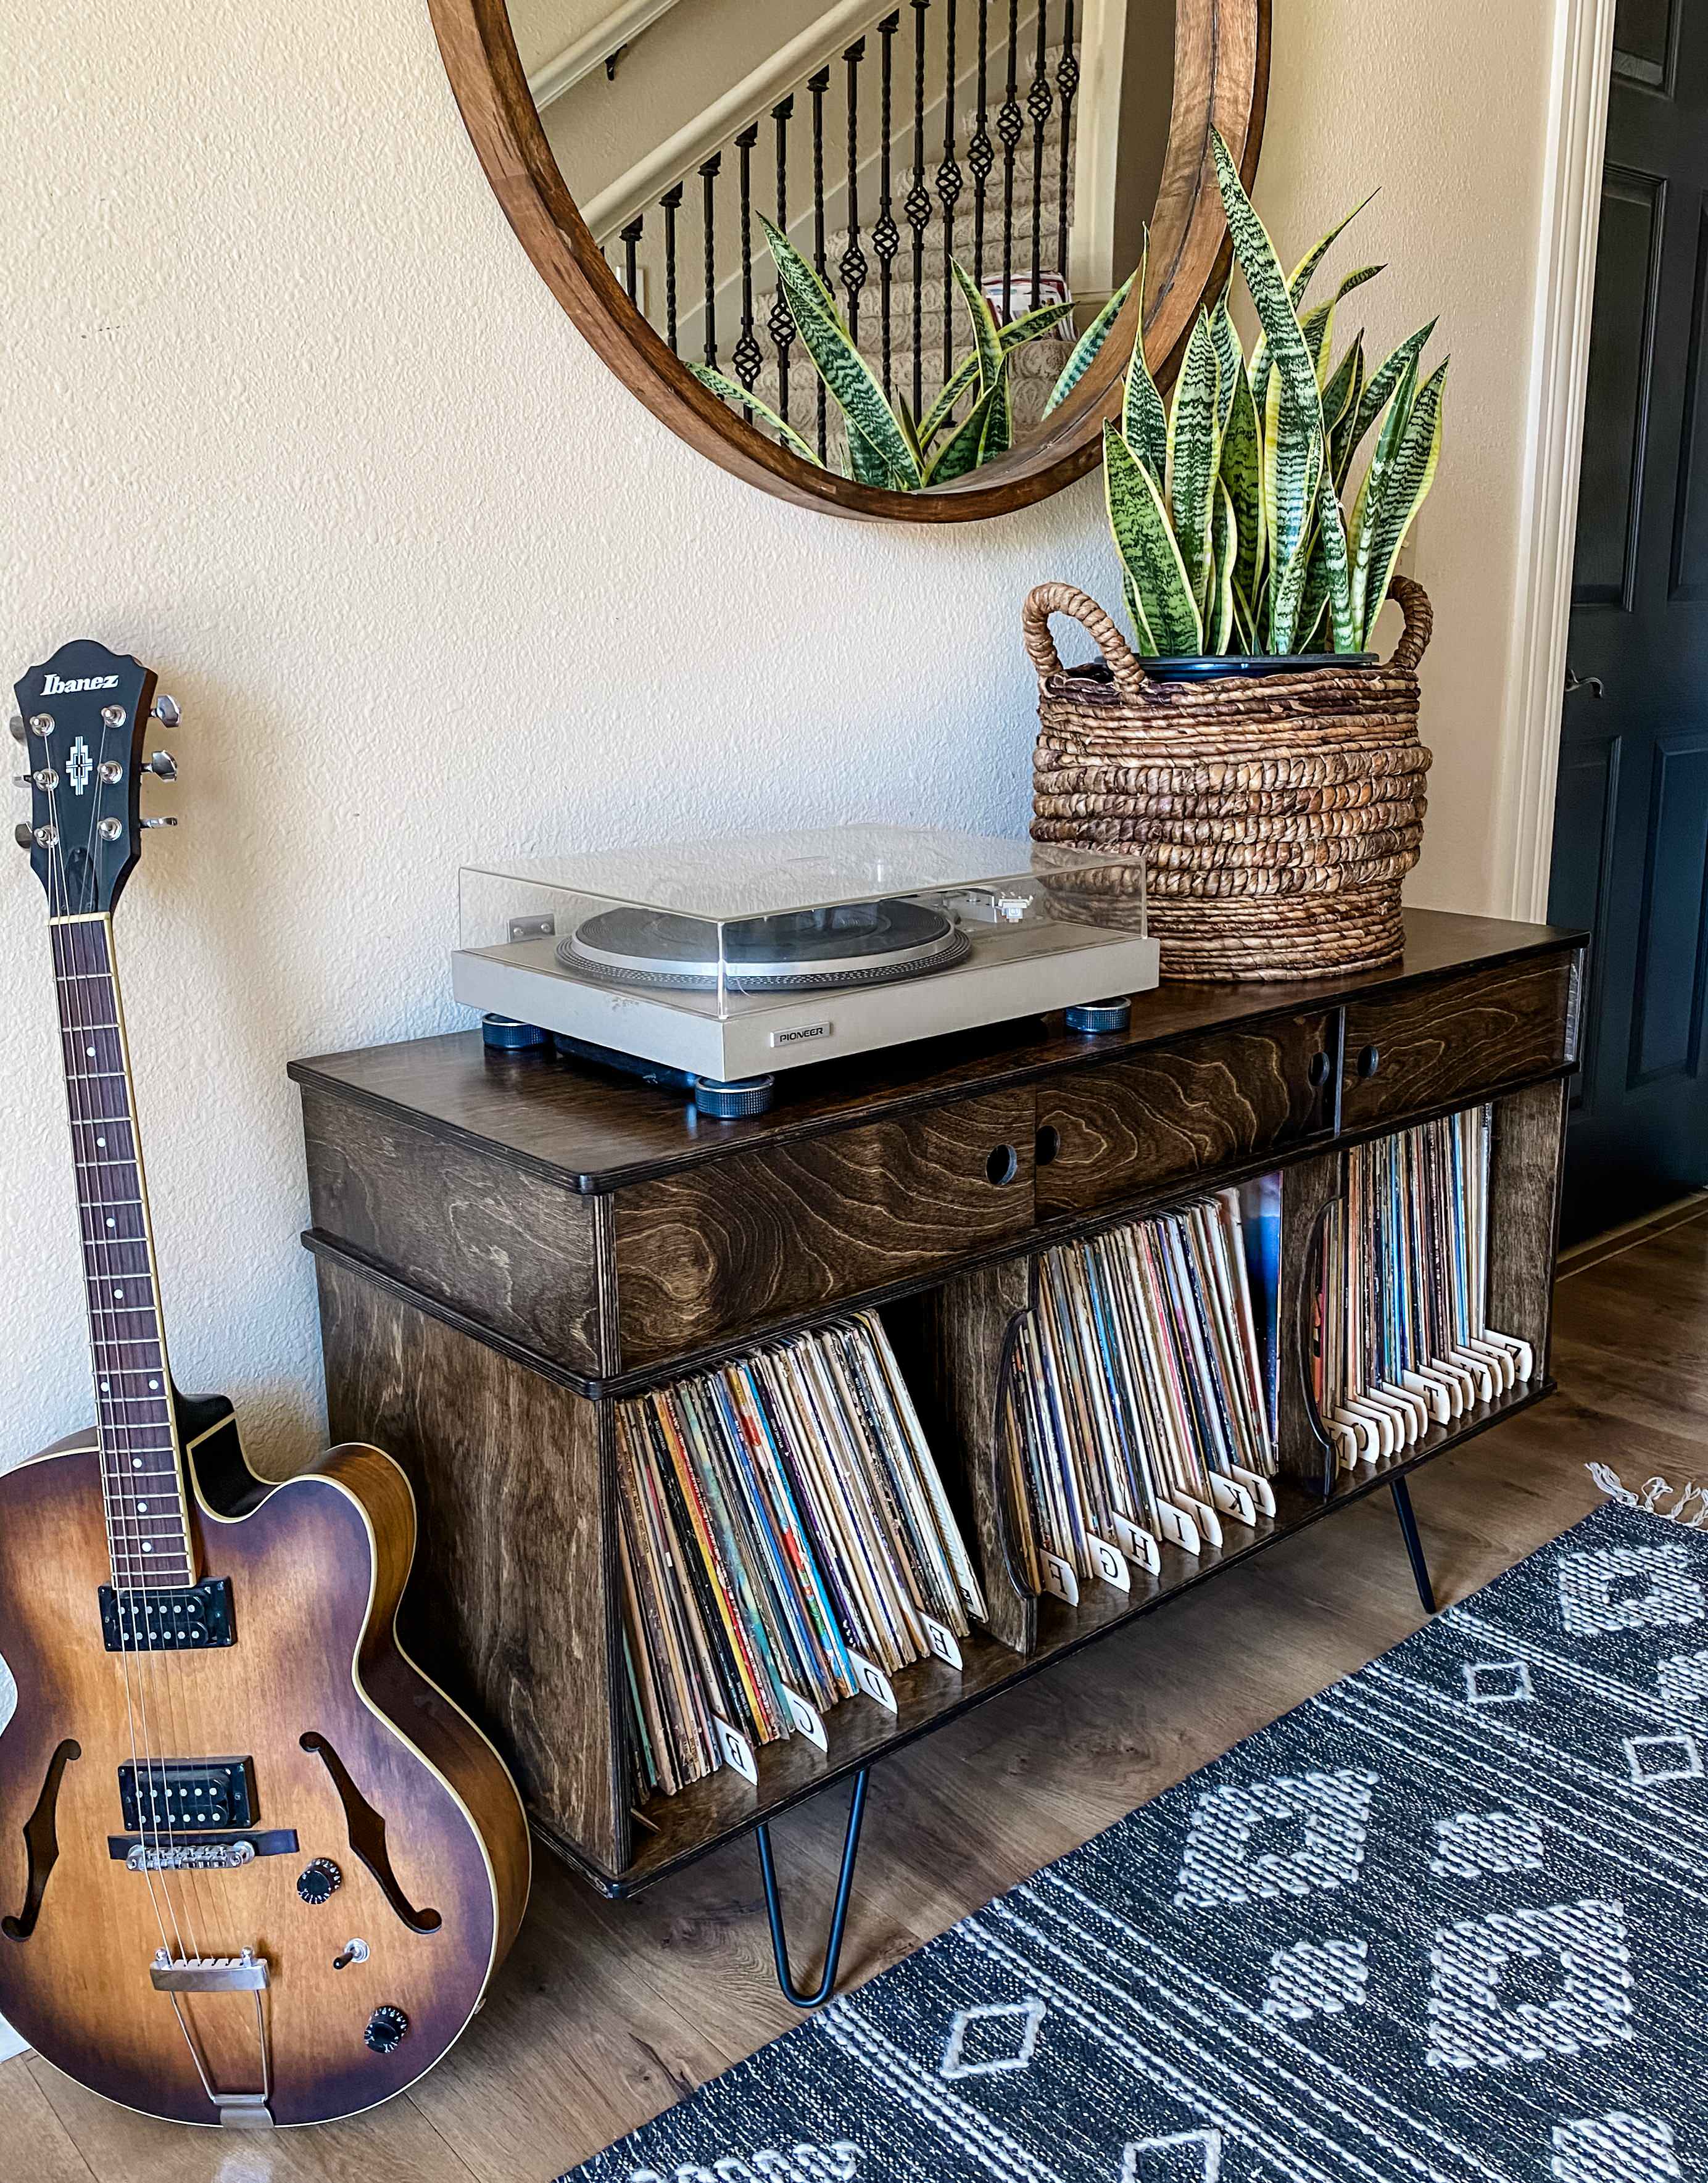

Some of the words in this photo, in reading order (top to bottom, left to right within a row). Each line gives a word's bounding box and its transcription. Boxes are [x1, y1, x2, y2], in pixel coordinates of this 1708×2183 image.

[39, 674, 118, 696] Ibanez
[779, 1027, 823, 1042] PIONEER
[1424, 1385, 1438, 1414] T
[1173, 1514, 1186, 1543] I
[1128, 1528, 1152, 1567] H
